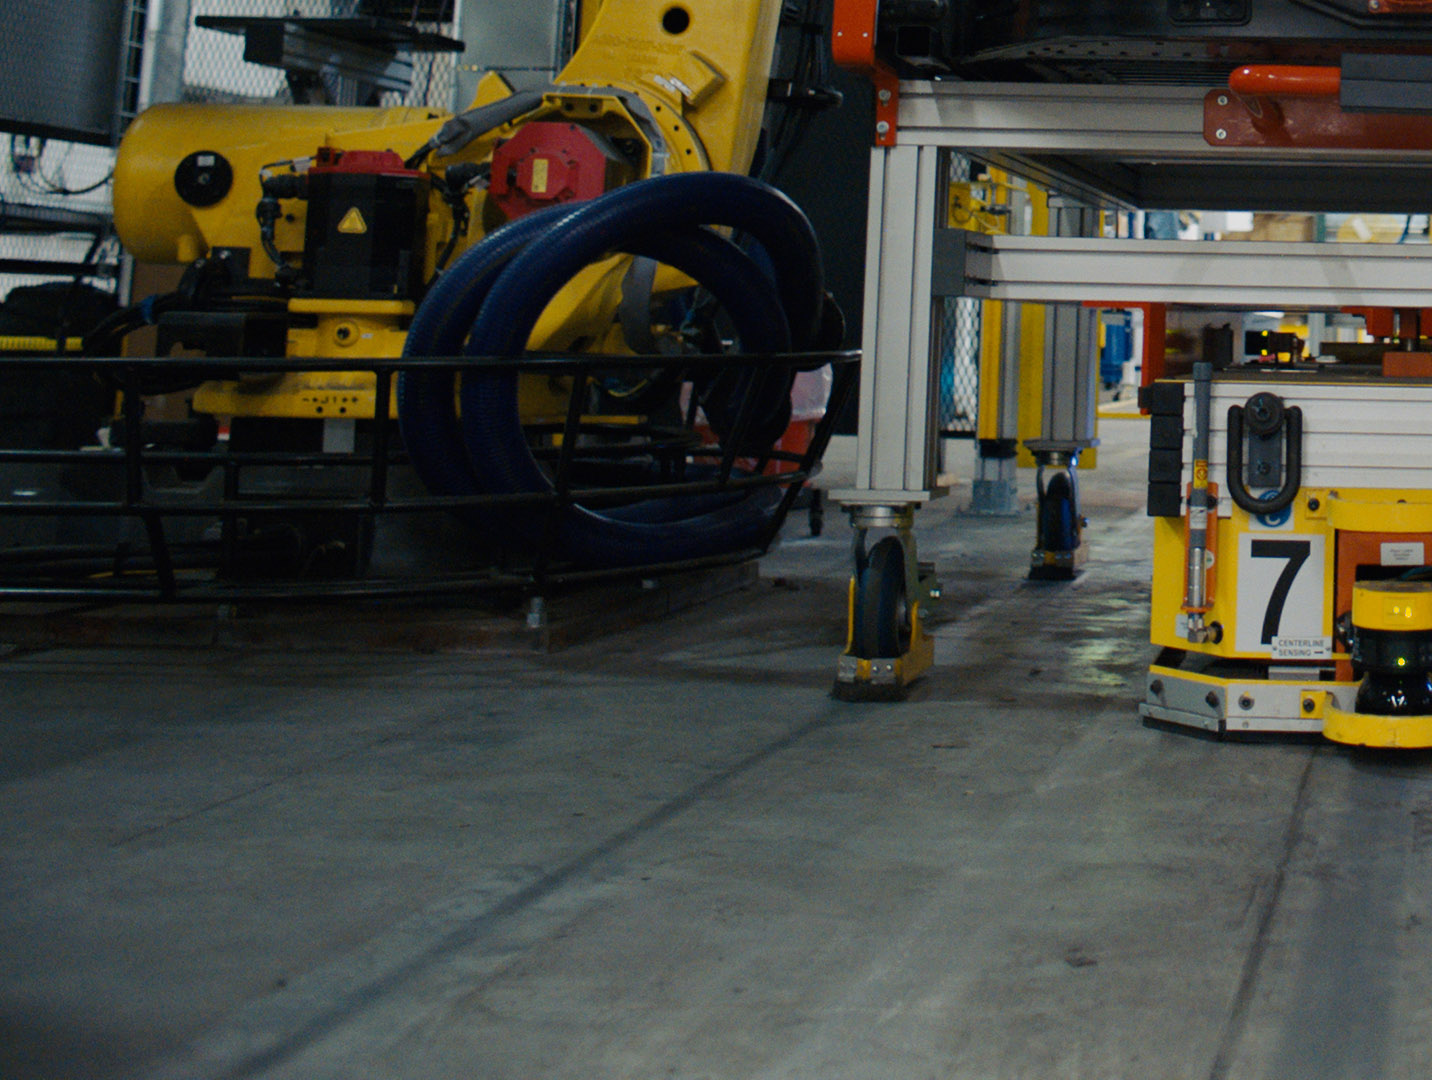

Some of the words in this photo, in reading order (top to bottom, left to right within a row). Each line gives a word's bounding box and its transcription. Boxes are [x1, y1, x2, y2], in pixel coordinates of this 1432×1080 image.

[1250, 539, 1311, 645] 7
[1278, 639, 1324, 647] CENTERLINE
[1278, 649, 1312, 657] SENSING
